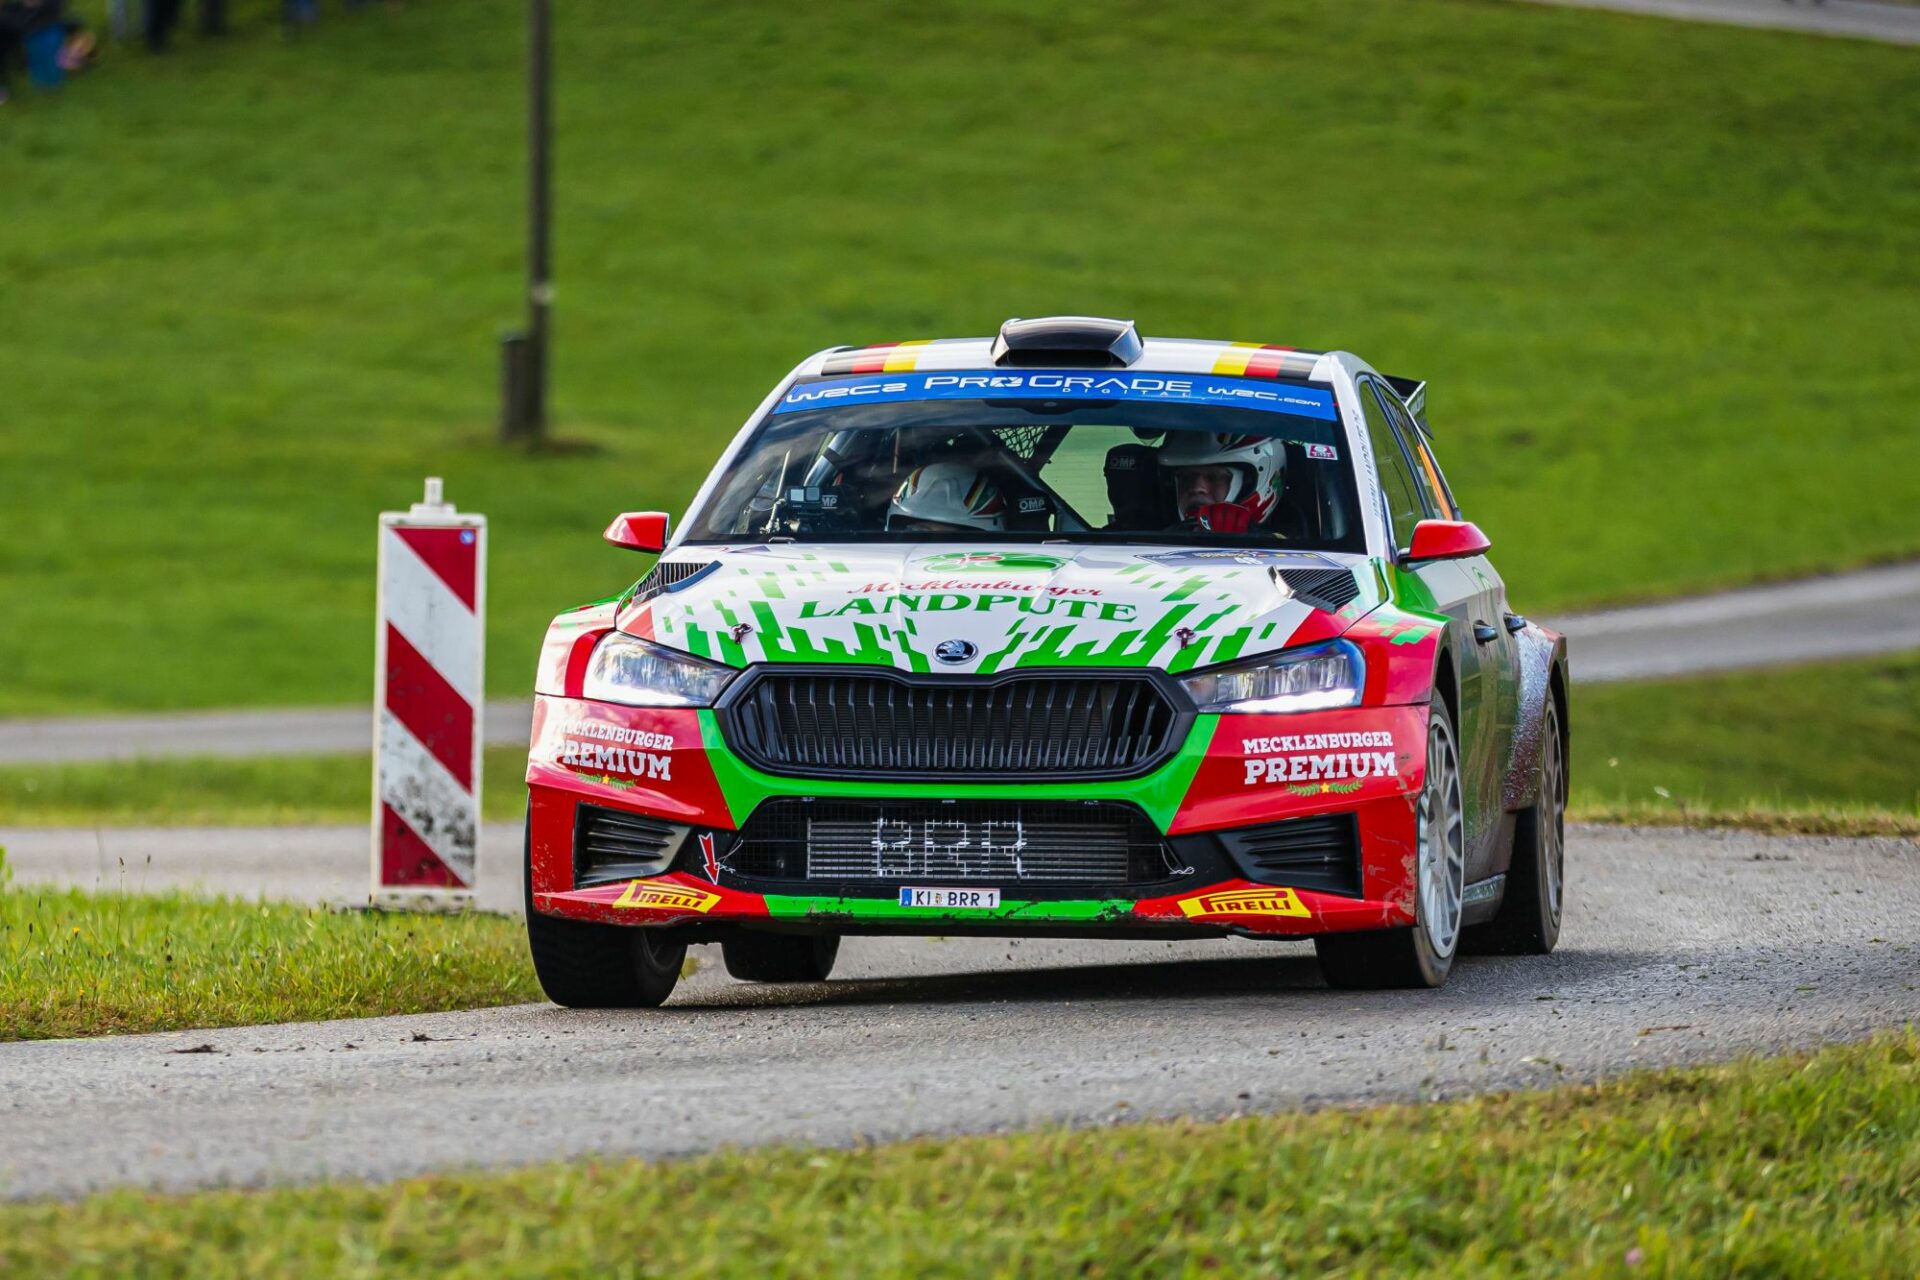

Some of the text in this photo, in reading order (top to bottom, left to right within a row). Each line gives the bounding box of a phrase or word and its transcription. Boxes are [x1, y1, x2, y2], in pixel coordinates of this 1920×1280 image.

[1062, 387, 1191, 398] DIGITAL
[1018, 499, 1046, 511] OMP
[847, 579, 1103, 597] Mecklenburger
[797, 593, 1138, 623] LANDPUTE
[559, 718, 674, 751] MCKLENBURGER
[1242, 731, 1393, 754] MECKLENBURGER
[1244, 751, 1398, 785] PREMIUM
[630, 882, 709, 908] PIRELLI
[916, 890, 994, 907] KI BRR 1
[1198, 890, 1292, 913] PIRELLI
